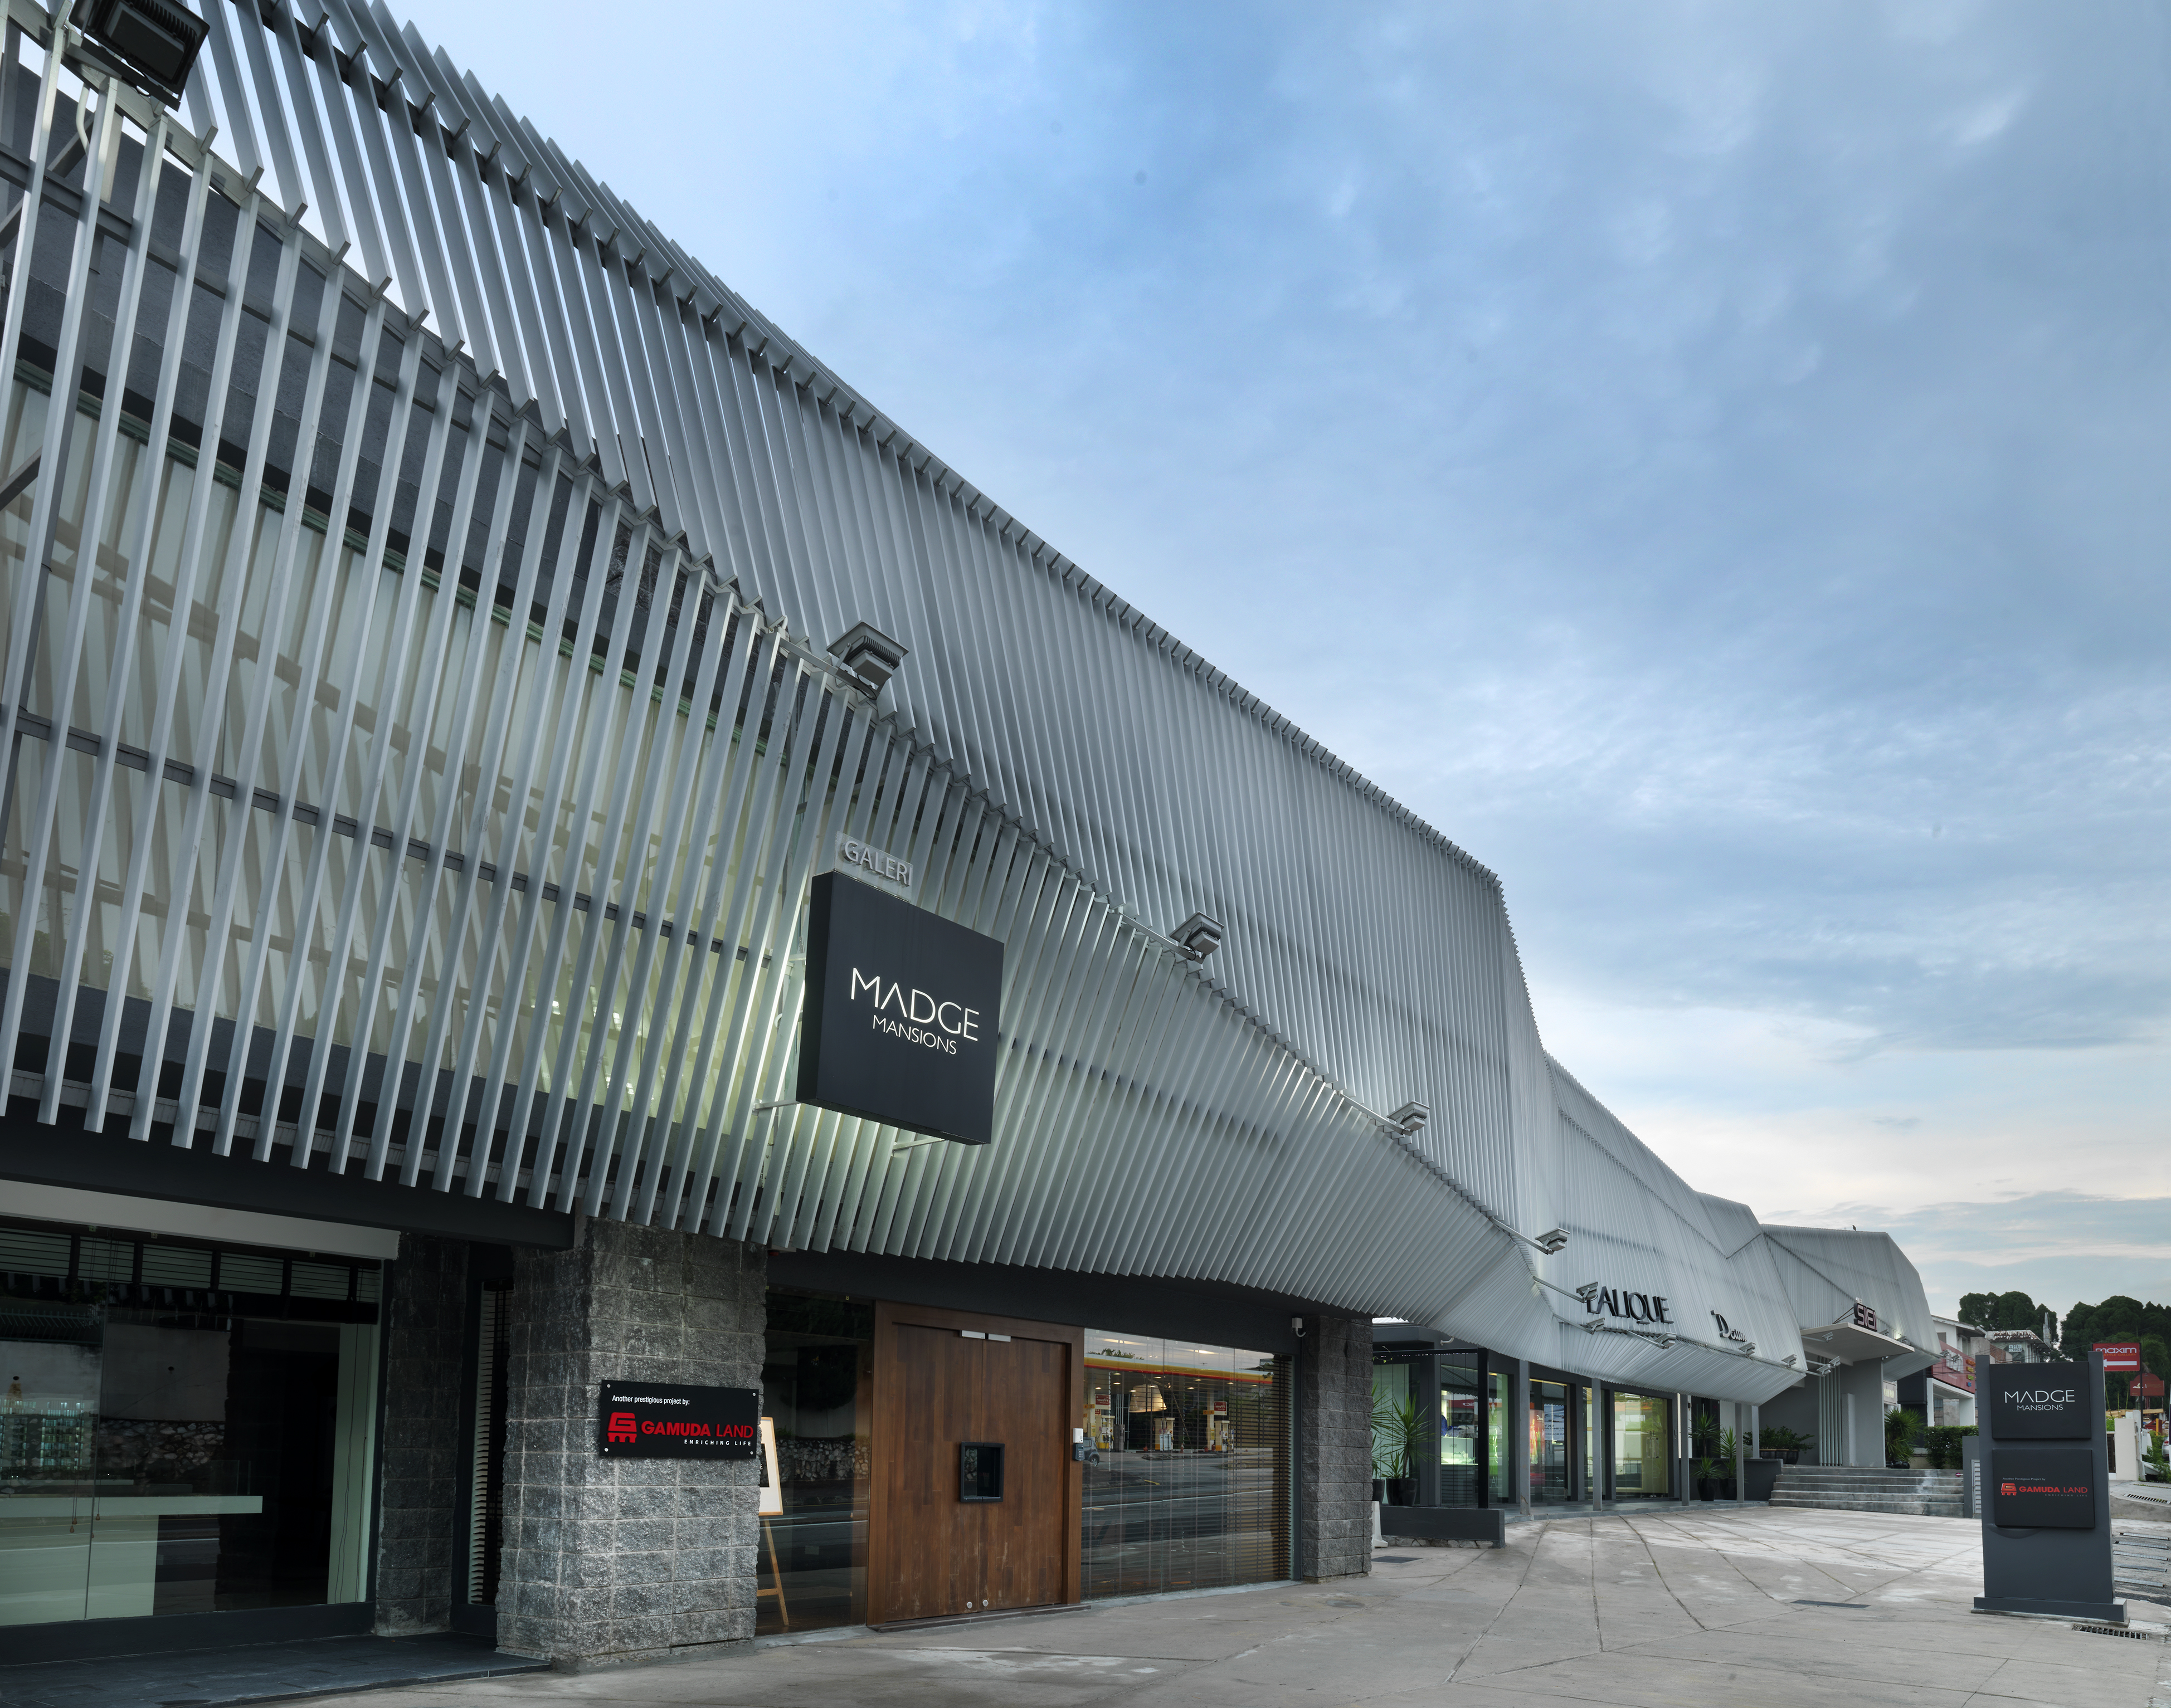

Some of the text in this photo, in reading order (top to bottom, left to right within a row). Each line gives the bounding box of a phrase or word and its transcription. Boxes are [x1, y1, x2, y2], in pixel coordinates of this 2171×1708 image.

[844, 840, 913, 886] GALERI
[850, 967, 980, 1042] MADGE
[872, 1014, 957, 1055] MANSIONS
[1710, 1310, 1747, 1342] Daum
[2004, 1389, 2075, 1403] MADGE
[641, 1421, 754, 1438] GAMUDA LAND
